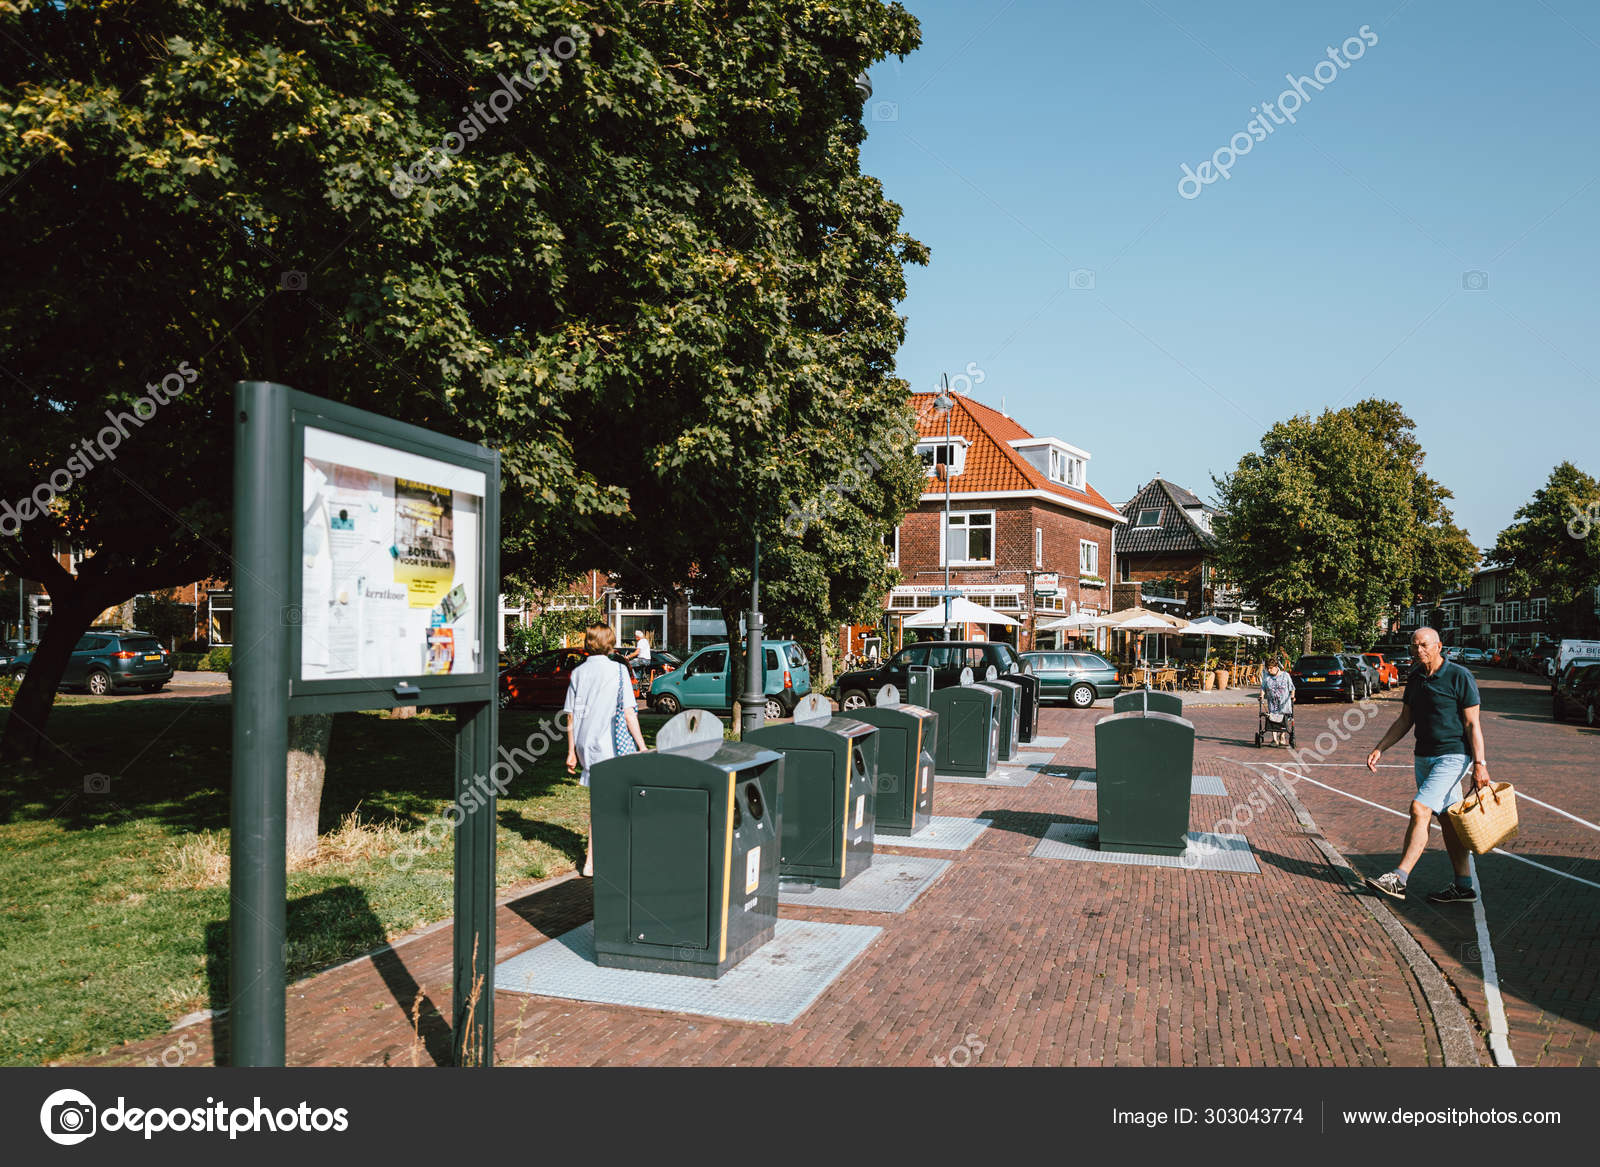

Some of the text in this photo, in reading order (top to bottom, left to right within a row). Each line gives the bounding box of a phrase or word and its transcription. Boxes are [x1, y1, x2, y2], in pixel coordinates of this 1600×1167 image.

[408, 545, 442, 560] BORREL
[420, 559, 428, 567] DE
[430, 560, 451, 569] BUURT
